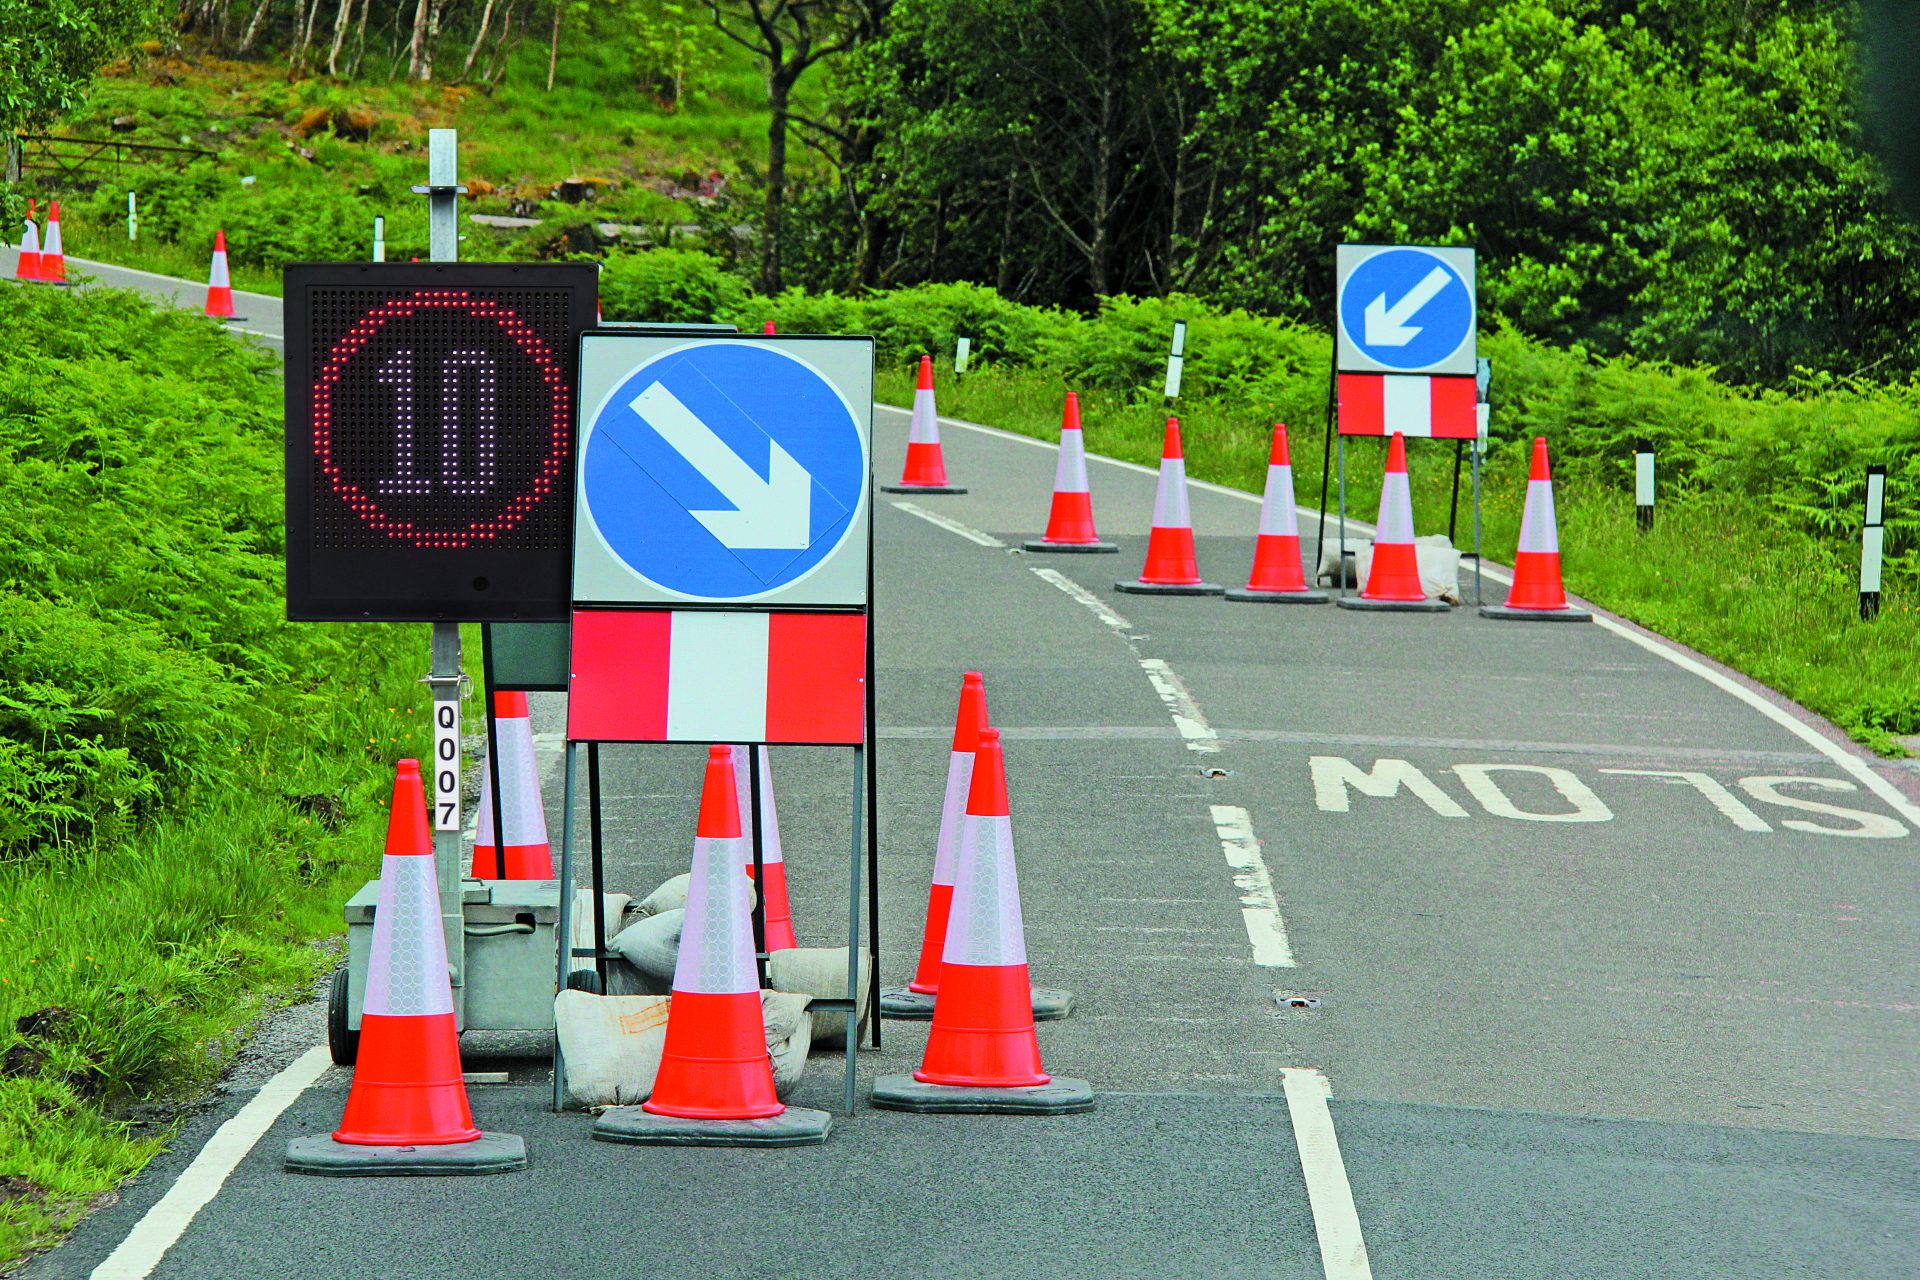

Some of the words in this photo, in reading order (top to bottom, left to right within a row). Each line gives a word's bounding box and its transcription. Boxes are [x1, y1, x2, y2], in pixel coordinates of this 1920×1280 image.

[377, 349, 496, 495] 10
[437, 705, 456, 825] Q0007
[1309, 755, 1910, 839] SLOW
